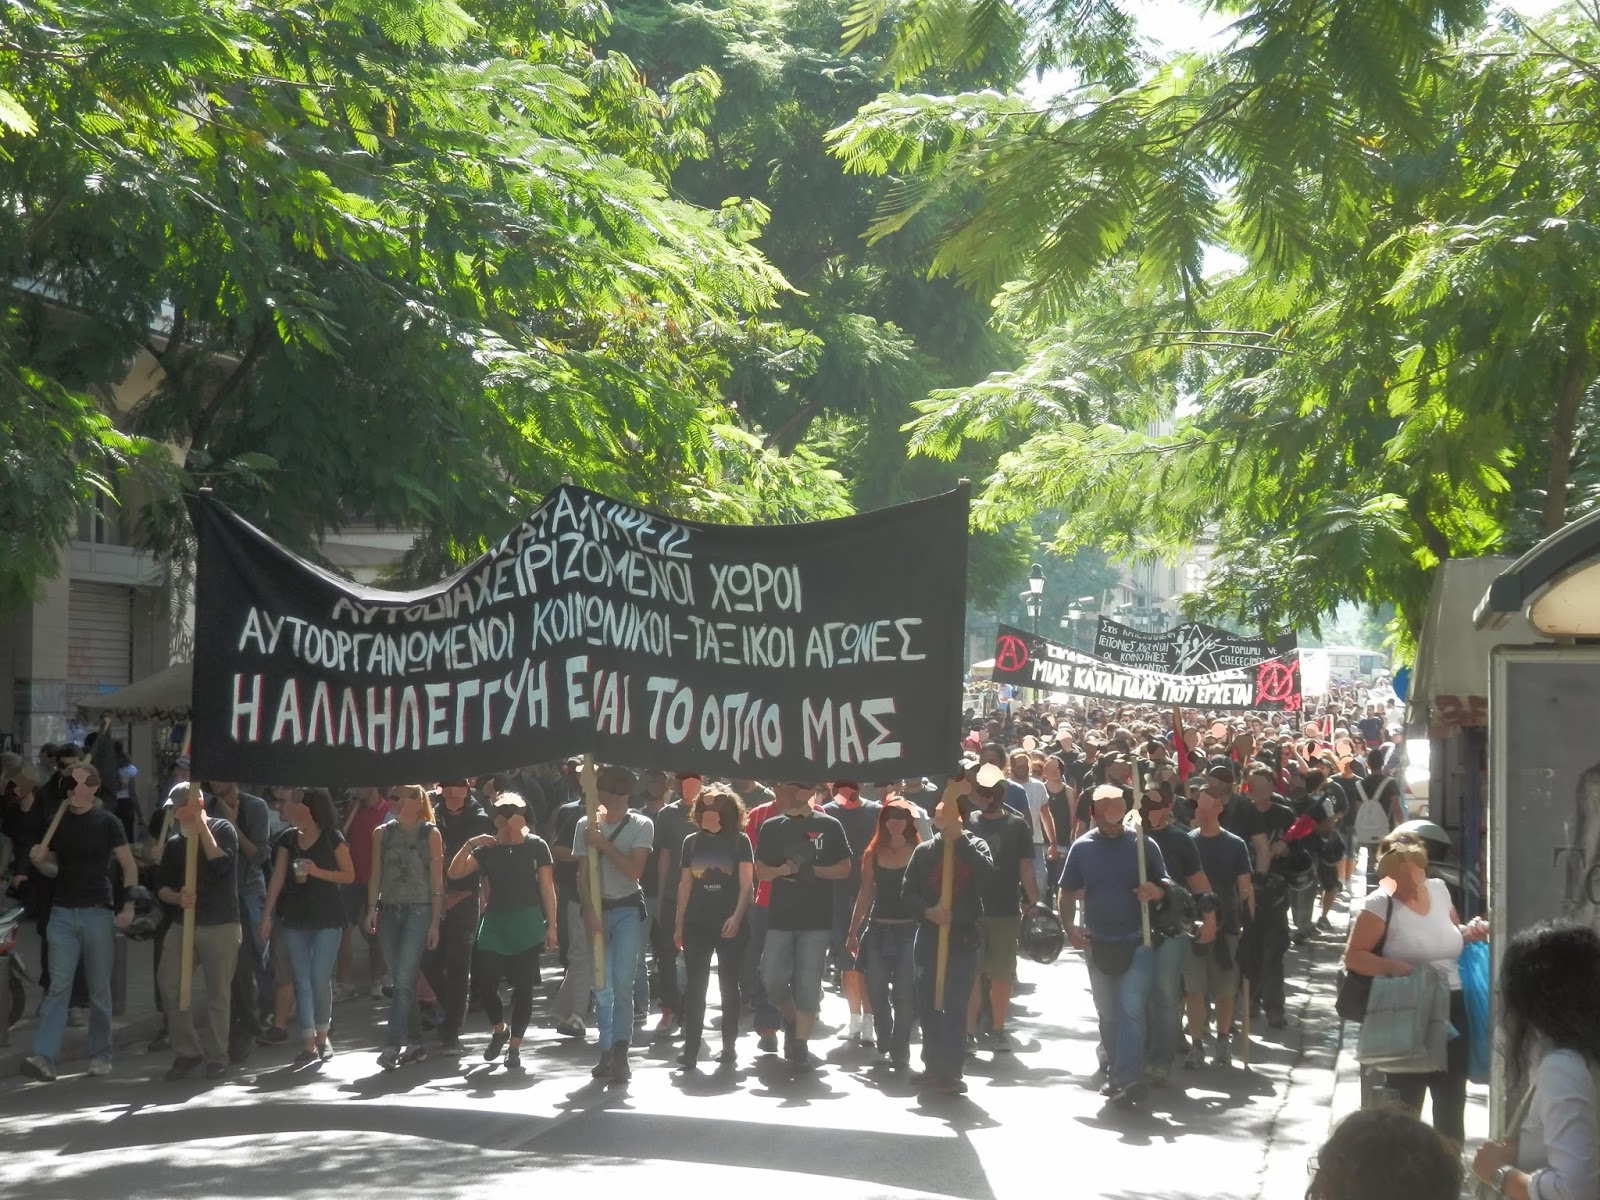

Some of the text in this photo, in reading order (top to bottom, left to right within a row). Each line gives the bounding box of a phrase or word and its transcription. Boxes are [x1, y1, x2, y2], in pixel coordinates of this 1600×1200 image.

[711, 564, 803, 613] ΧΩΡΟΙ
[806, 617, 926, 669] ΑΓΩΝΕΣ
[1031, 658, 1072, 688] ΜΙΑΣ
[1161, 680, 1195, 703] ΠΟΥ
[1195, 682, 1254, 707] ΕΡΧΕΤΑΙ
[231, 673, 263, 742] Η
[272, 658, 551, 754] ΑΛΛΗΛΕΓΓΥΗ
[647, 676, 695, 744] ΤΟ
[700, 692, 783, 764] ΟΠΛΟ
[803, 697, 903, 768] ΜΑΣ
